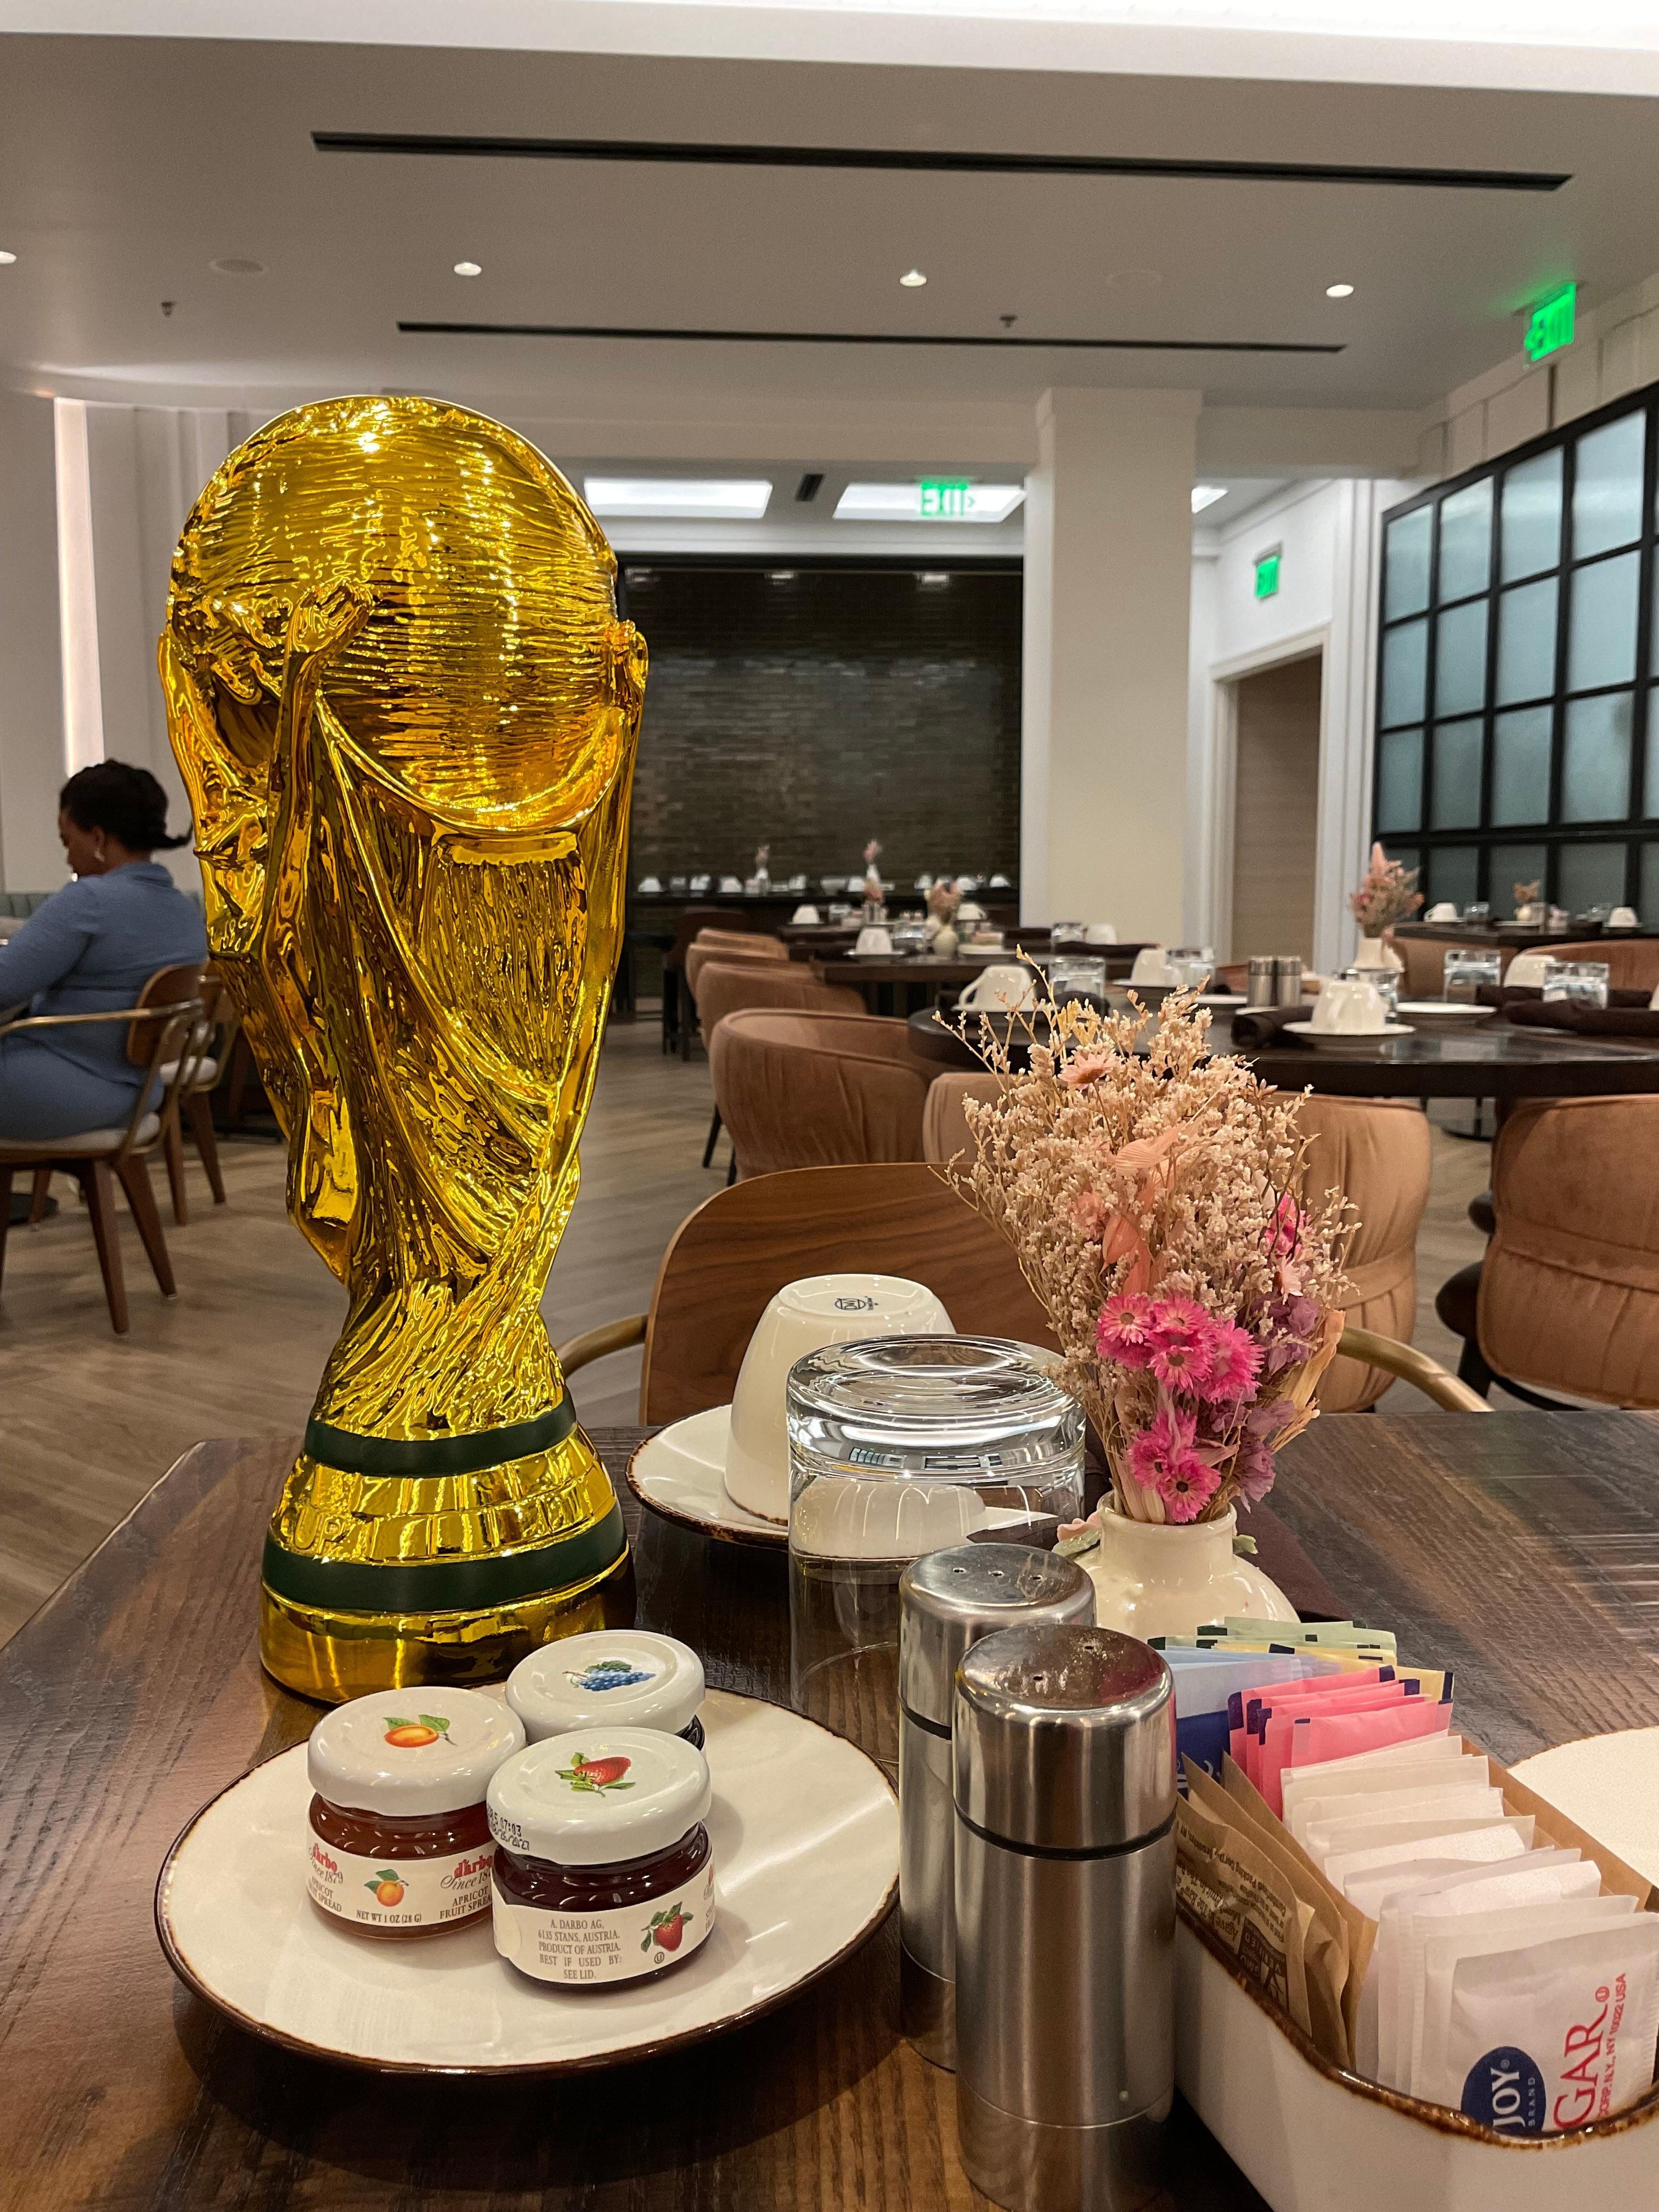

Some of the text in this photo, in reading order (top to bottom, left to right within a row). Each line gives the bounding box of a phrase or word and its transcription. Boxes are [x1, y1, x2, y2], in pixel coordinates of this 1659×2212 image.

[325, 1870, 343, 1884] 1879
[440, 1875, 477, 1891] Since
[318, 1893, 342, 1912] SPREAD
[452, 1886, 488, 1908] APRICOT
[439, 1904, 467, 1920] FRUIT
[1197, 1897, 1207, 1919] The
[356, 1910, 422, 1924] NET WT 1 OZ (28 G)
[550, 1919, 558, 1928] A.
[560, 1920, 588, 1929] DARBO
[538, 1929, 620, 1943] 6135 STANS, AUSTRIA.
[1216, 1916, 1239, 1942] Agave
[539, 1941, 621, 1955] PRODUCT OF AUSTRIA.
[540, 1954, 622, 1967] BEST IF USED BY:
[563, 1970, 597, 1979] SEE LID.
[1606, 2037, 1616, 2056] NY
[1615, 1972, 1626, 2002] USA
